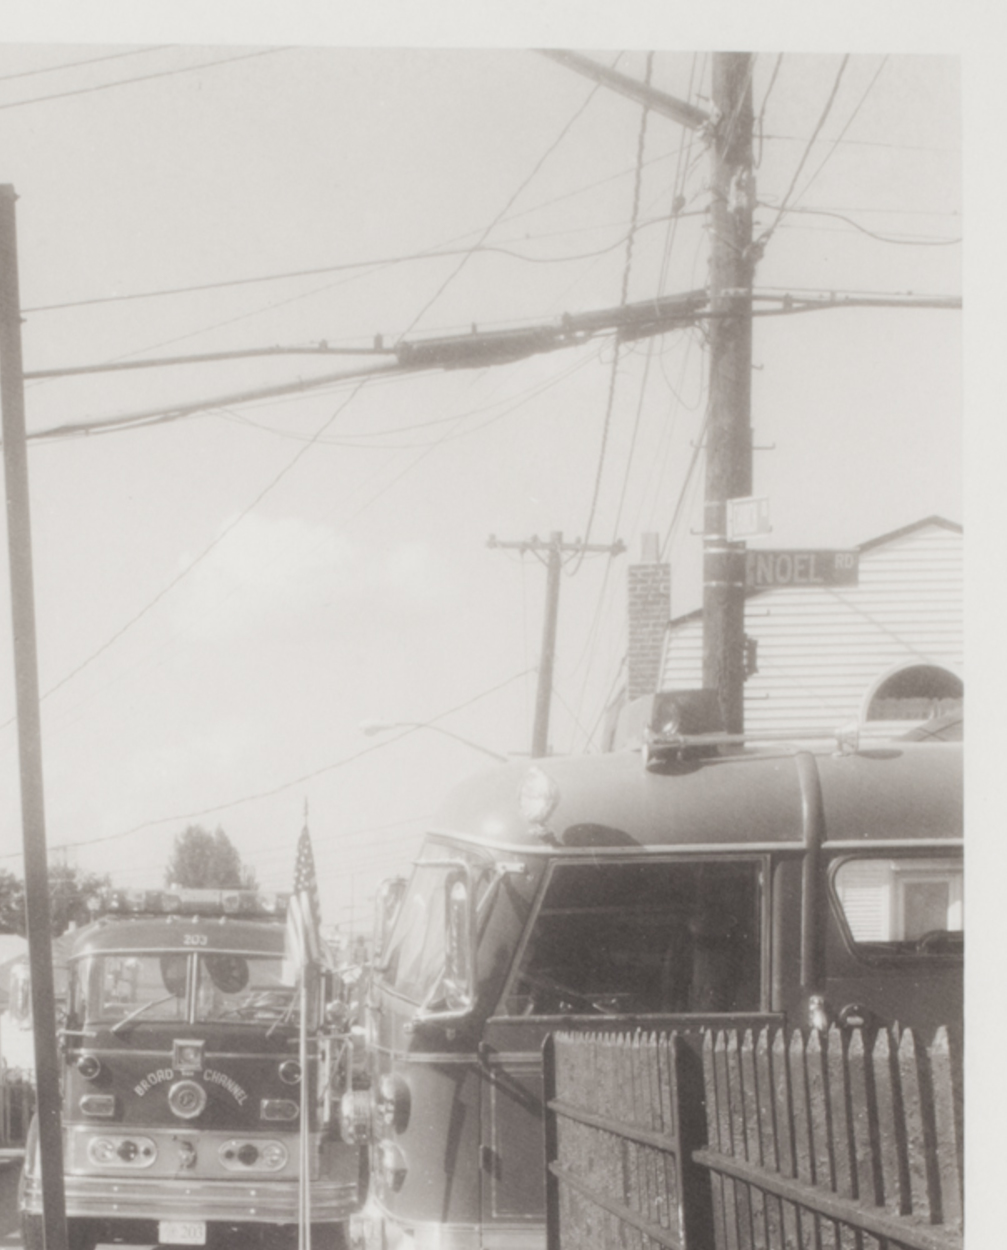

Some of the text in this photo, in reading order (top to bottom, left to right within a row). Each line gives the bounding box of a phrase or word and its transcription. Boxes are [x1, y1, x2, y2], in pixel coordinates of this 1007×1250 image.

[756, 553, 854, 583] NOEL RD
[183, 934, 208, 946] 203
[134, 1068, 248, 1106] BROAD CHANNEL
